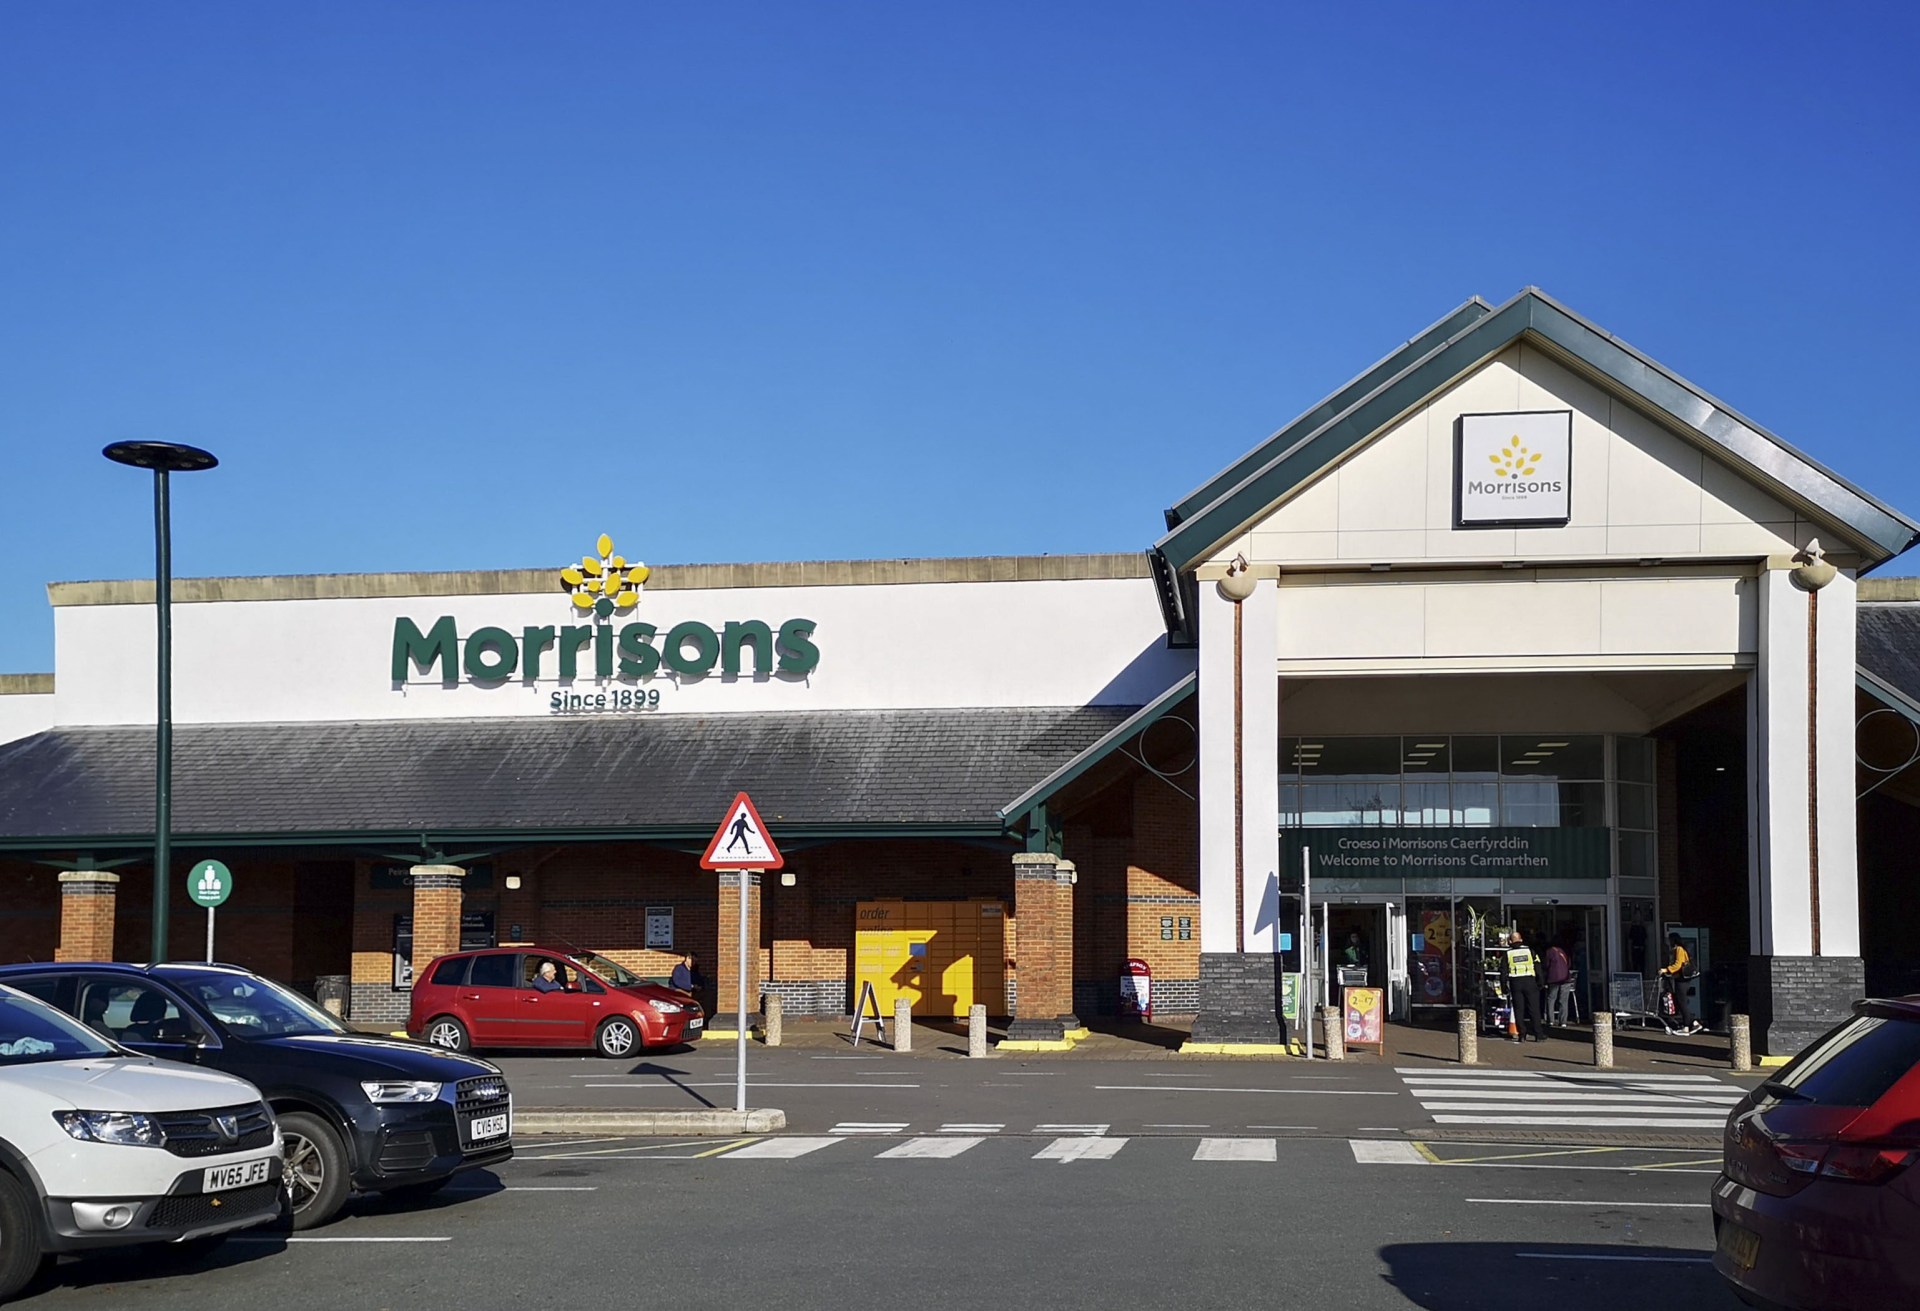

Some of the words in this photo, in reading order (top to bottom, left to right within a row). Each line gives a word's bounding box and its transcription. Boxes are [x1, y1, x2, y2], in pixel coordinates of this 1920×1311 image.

[1468, 481, 1562, 495] Morrisons
[393, 615, 820, 683] Morrisons
[550, 690, 607, 708] Since
[611, 689, 660, 706] 1899
[1338, 837, 1381, 850] Croeso
[1382, 837, 1387, 849] i
[1388, 837, 1448, 850] Morrisons
[1450, 836, 1530, 853] Caerfyrddin
[1319, 853, 1381, 866] Welcome
[1382, 855, 1399, 866] to
[1401, 854, 1467, 867] Morrisons
[1470, 853, 1549, 867] Carmarthen
[860, 907, 891, 920] order
[209, 1166, 243, 1189] MV65
[244, 1162, 266, 1183] JFE
